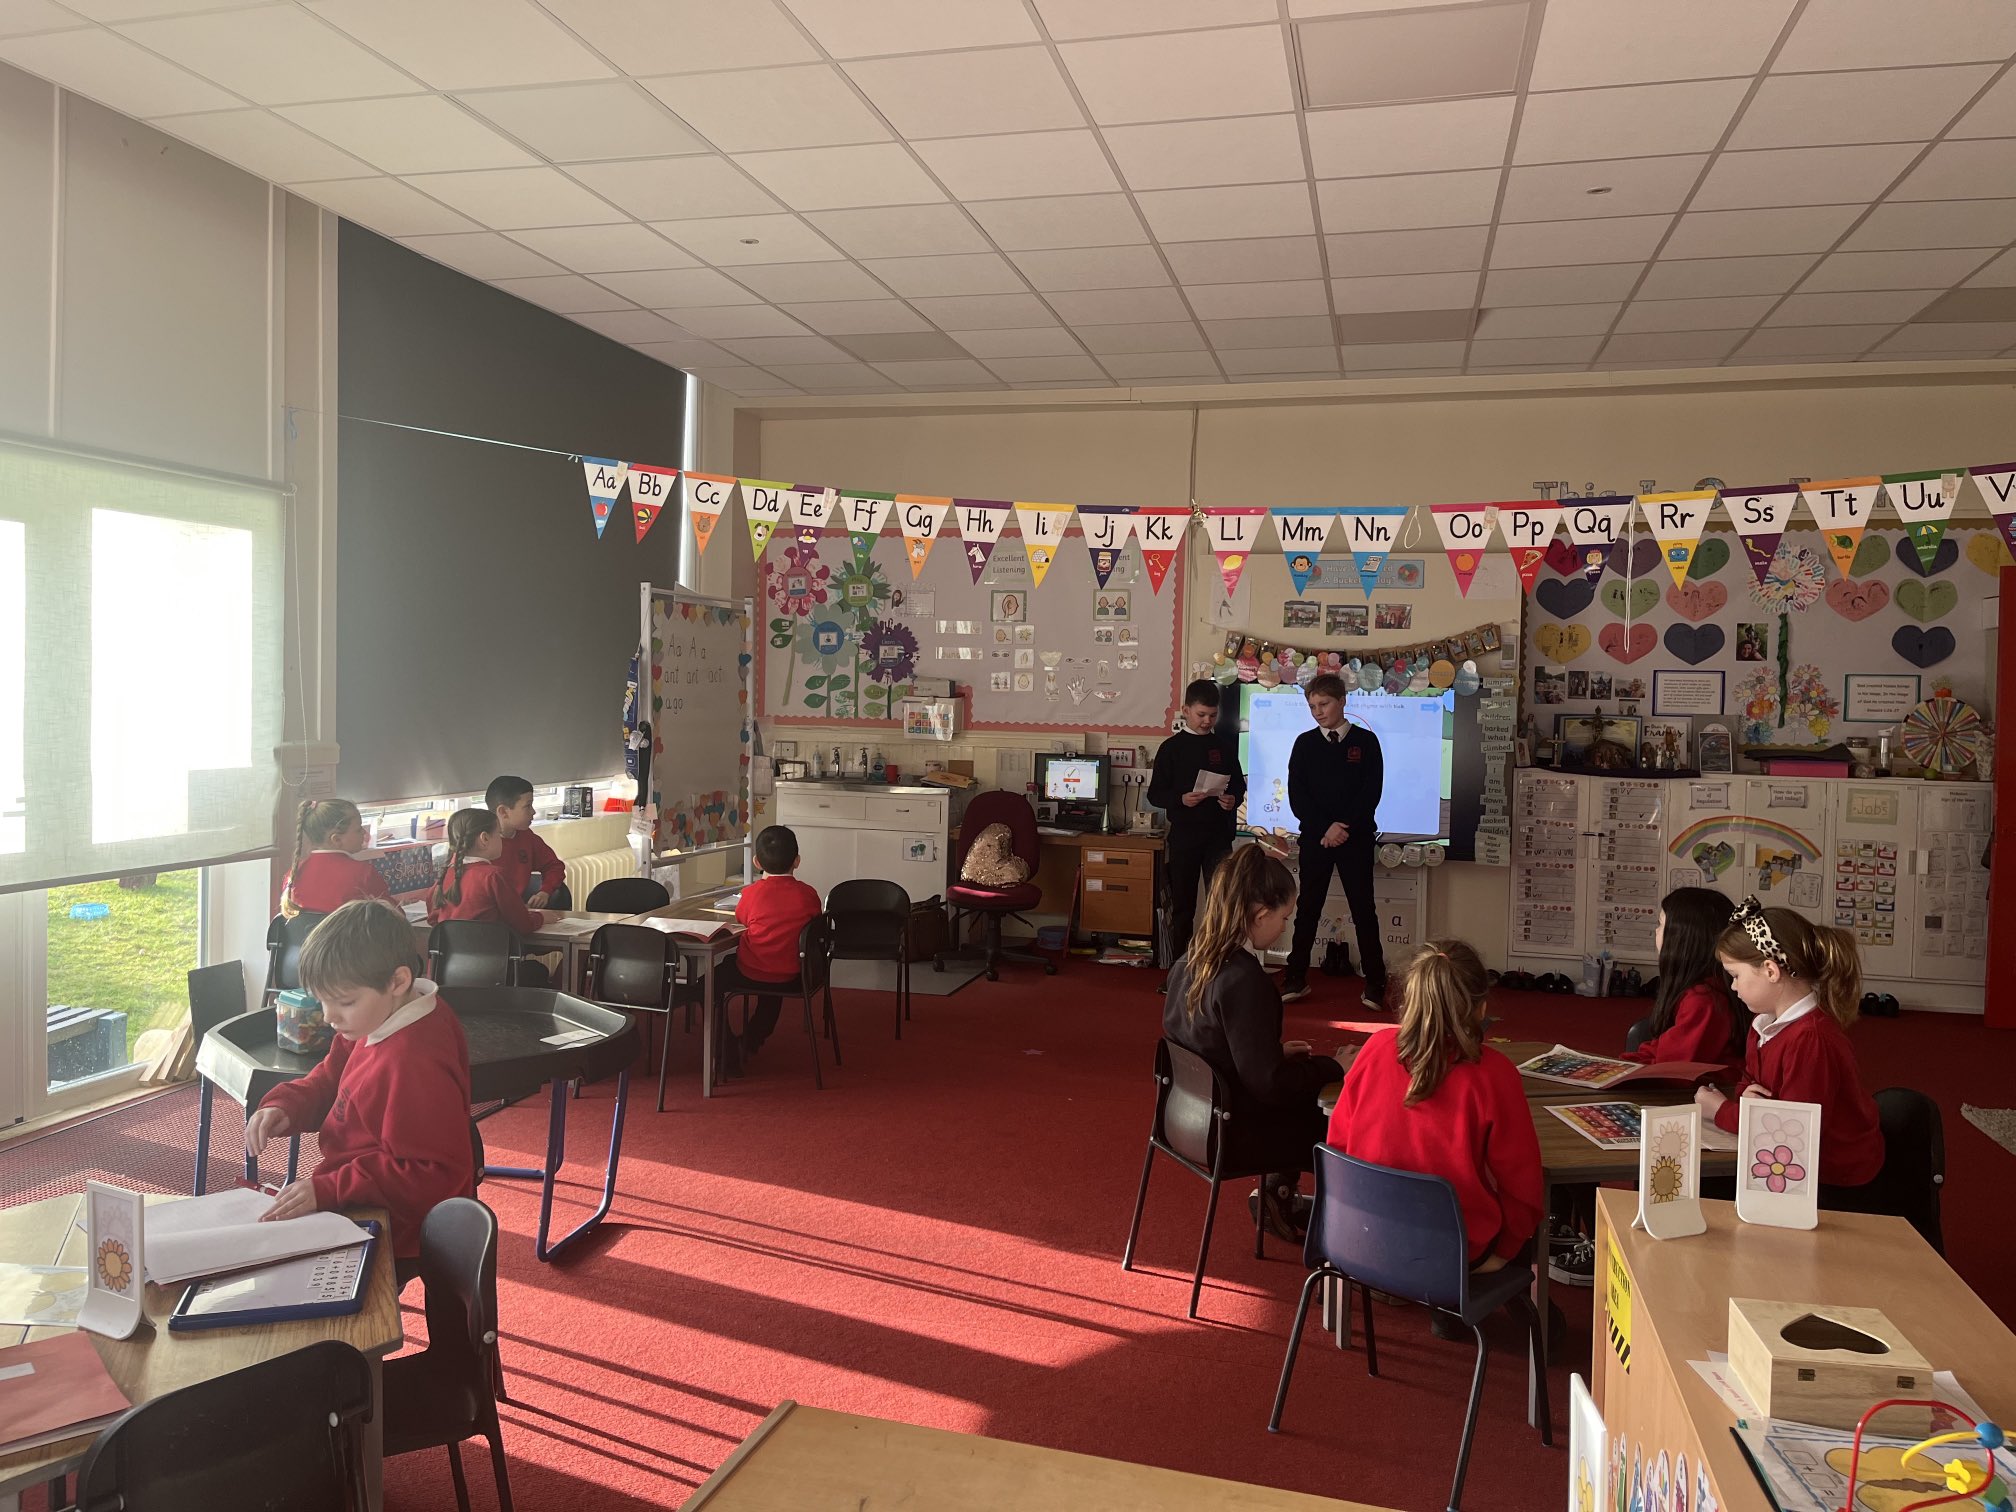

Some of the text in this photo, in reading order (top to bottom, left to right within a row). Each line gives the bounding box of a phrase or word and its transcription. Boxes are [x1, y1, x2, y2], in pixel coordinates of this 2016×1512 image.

[593, 466, 617, 490] Aa
[638, 473, 663, 497] Bb
[1988, 473, 2016, 503] V
[695, 482, 721, 505] Cc
[753, 488, 779, 513] Dd
[799, 494, 823, 518] Ee
[1820, 490, 1859, 518] Tt
[1903, 482, 1945, 512] Uu
[853, 500, 878, 531] Ff
[905, 504, 933, 537] Gg
[966, 510, 994, 533] Hh
[1660, 503, 1694, 530] Rr
[1743, 497, 1775, 524] Ss
[1035, 512, 1048, 536] Ii
[1094, 515, 1116, 548] Jj
[1145, 517, 1174, 540] Kk
[1220, 517, 1244, 541] Ll
[1282, 516, 1324, 542] Mm
[1354, 516, 1391, 542] Nn
[1449, 513, 1483, 539] Oo
[1512, 511, 1545, 546] Pp
[1573, 508, 1616, 543] Qq
[992, 567, 1025, 575] Listening
[1481, 713, 1511, 721] children
[1484, 725, 1509, 733] barked
[1391, 915, 1403, 926] a
[1386, 934, 1410, 945] and
